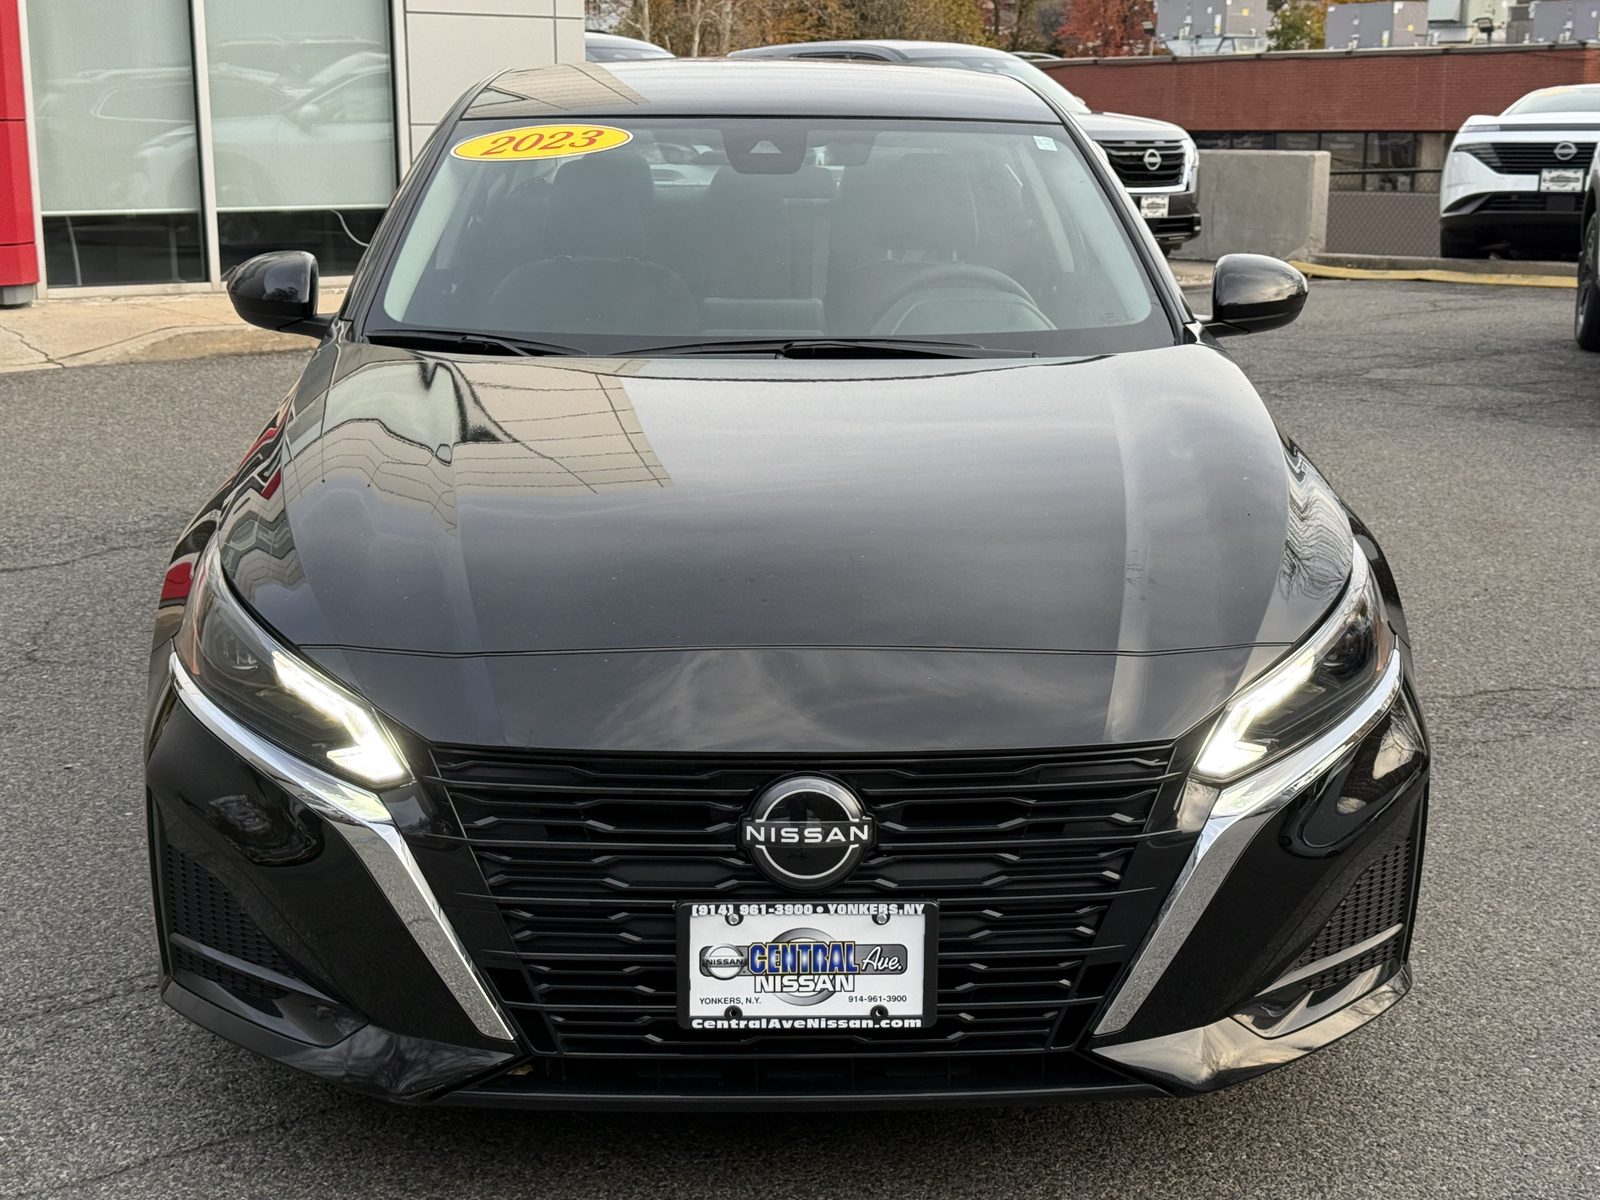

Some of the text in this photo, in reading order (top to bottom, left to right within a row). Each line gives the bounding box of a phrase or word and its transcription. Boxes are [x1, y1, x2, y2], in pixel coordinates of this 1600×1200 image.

[479, 130, 604, 156] 2023
[746, 825, 869, 843] NISSAN
[740, 904, 813, 915] 961-3900
[704, 958, 744, 966] NISSAN
[748, 941, 903, 974] CENTRAL Ave.
[754, 974, 855, 992] NISSAN
[699, 997, 743, 1006] YONKERS,
[848, 995, 907, 1003] 914-961-3900
[691, 1018, 922, 1029] CentralAveNissan.com
